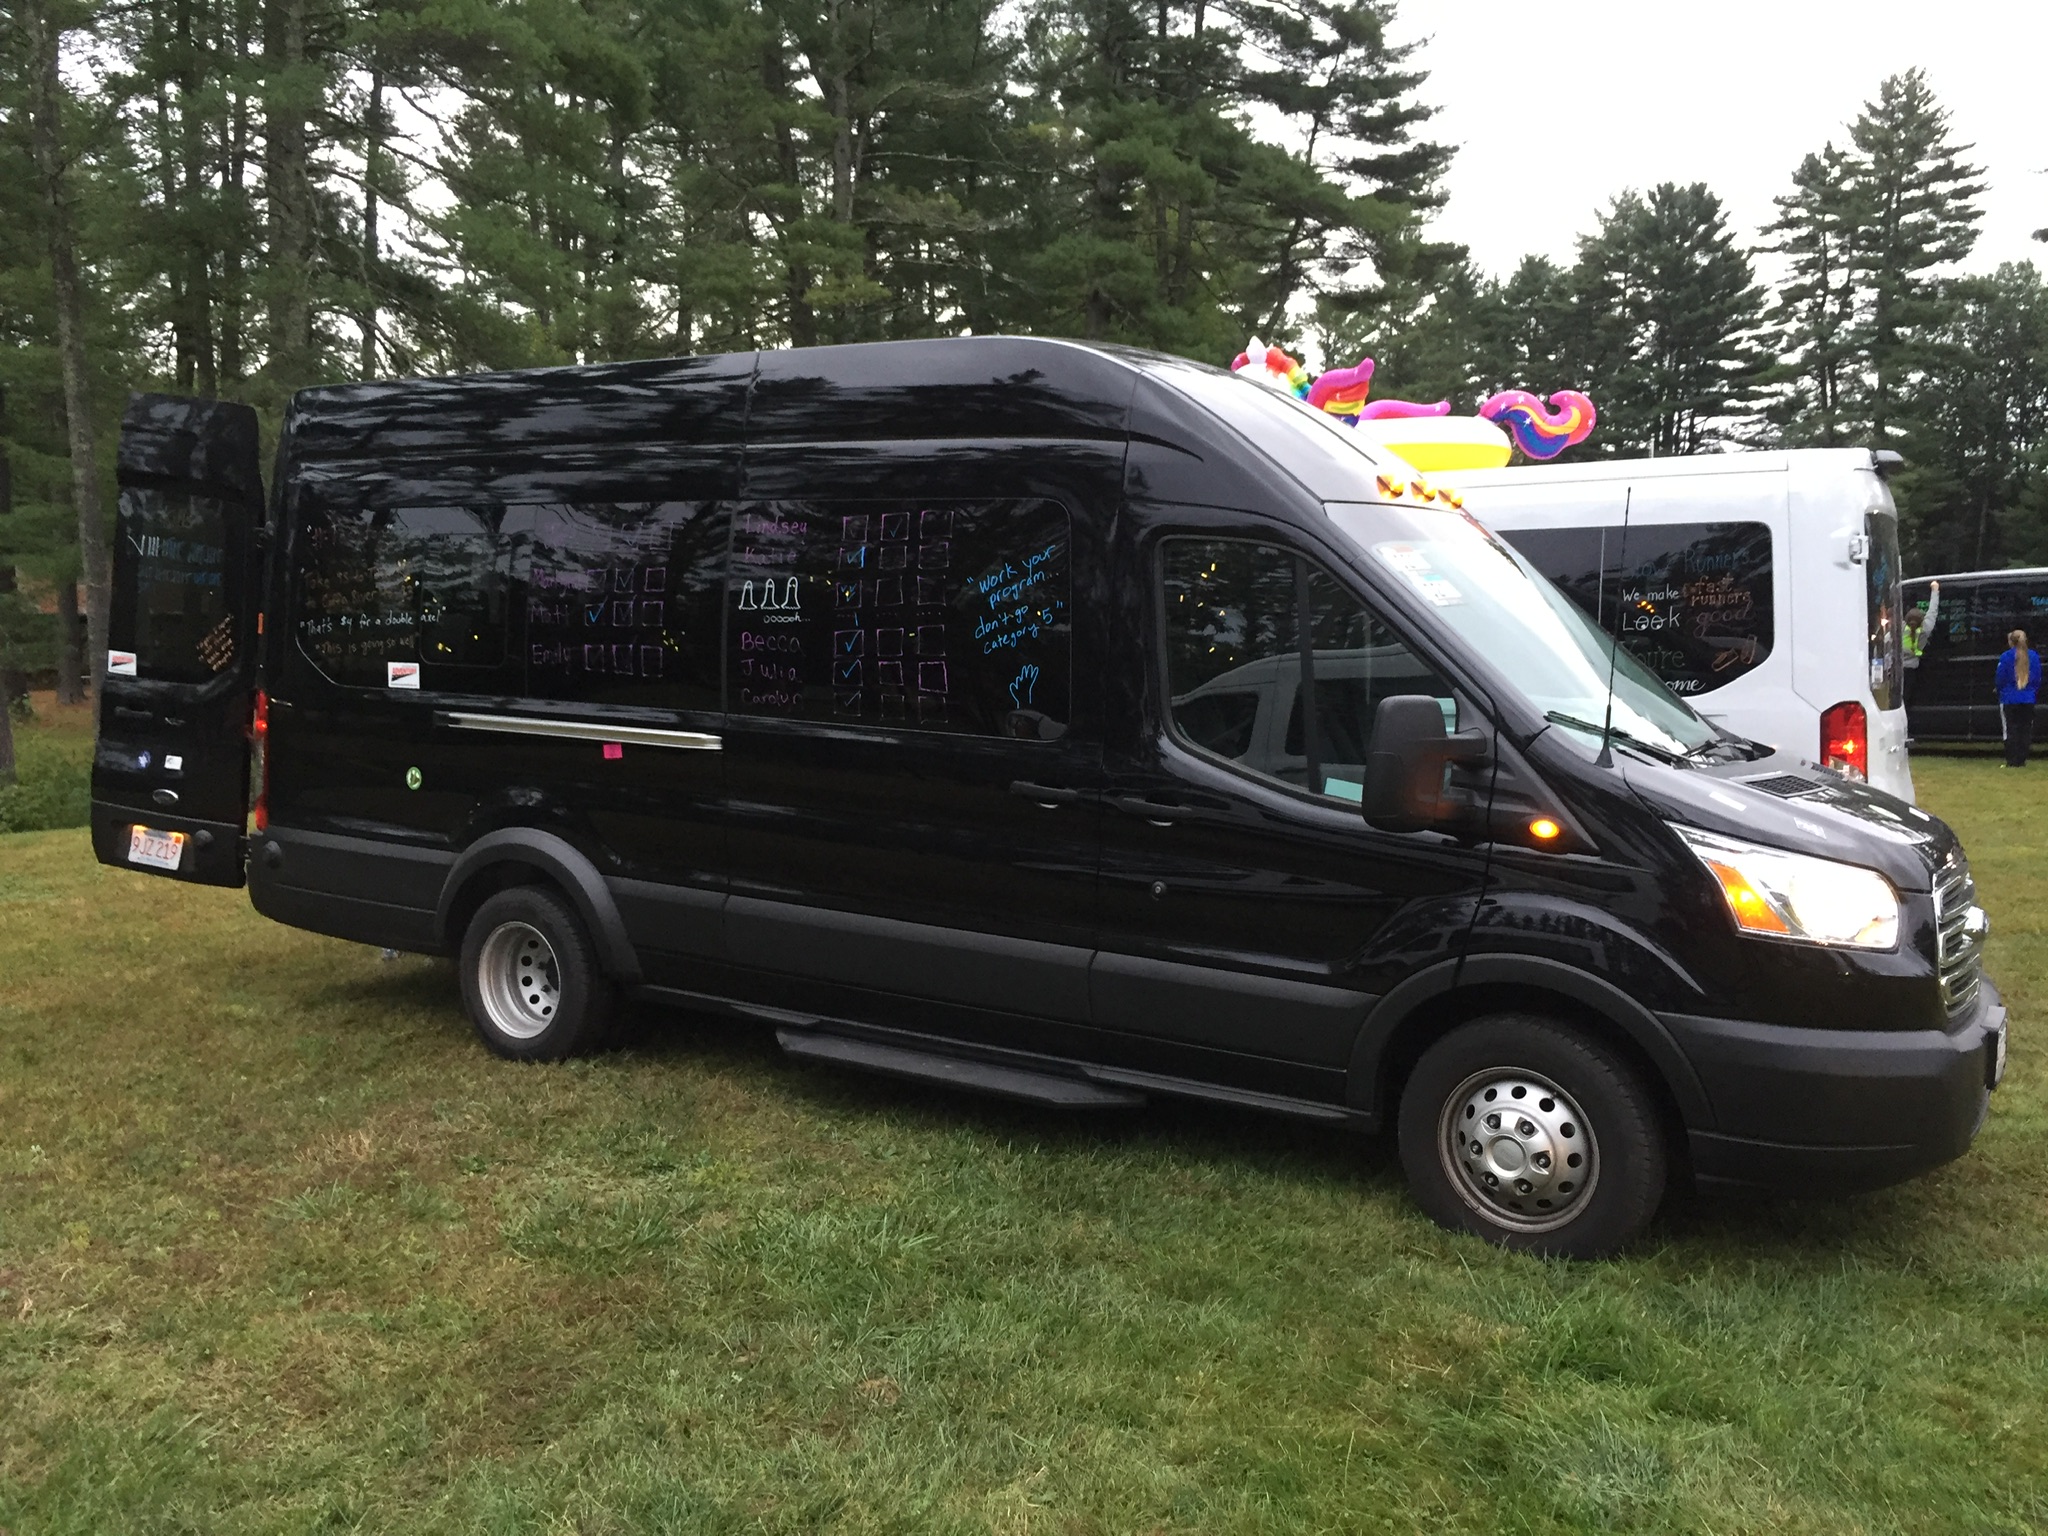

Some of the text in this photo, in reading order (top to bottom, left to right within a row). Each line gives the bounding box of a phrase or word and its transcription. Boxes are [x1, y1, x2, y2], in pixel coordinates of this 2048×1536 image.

[1021, 544, 1056, 579] your
[1622, 587, 1641, 602] We
[1647, 582, 1681, 601] make
[1691, 591, 1752, 608] runners
[385, 609, 415, 626] double
[974, 604, 1030, 640] don't go
[1622, 600, 1755, 639] Look good
[741, 631, 807, 657] Becca
[982, 622, 1041, 655] category
[741, 658, 804, 684] Julia
